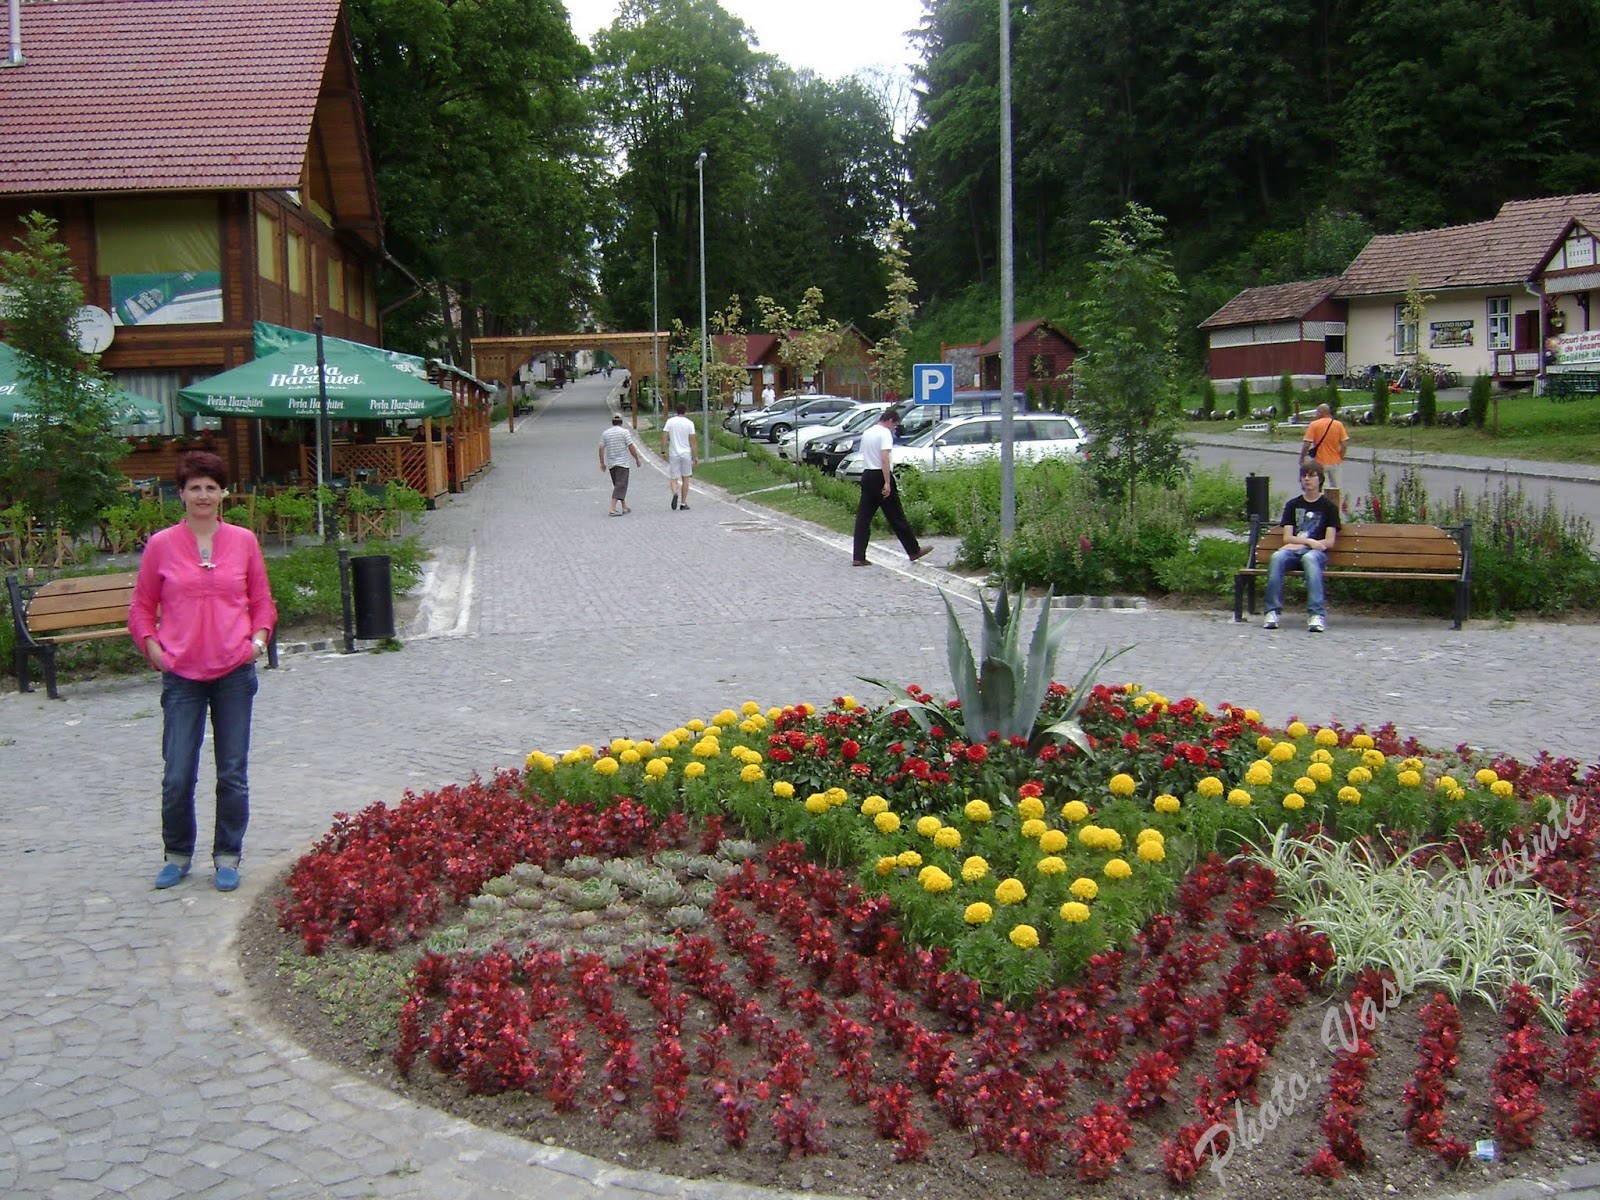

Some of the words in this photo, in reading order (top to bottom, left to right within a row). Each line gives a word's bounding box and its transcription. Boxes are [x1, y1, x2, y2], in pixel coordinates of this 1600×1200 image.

[1556, 335, 1579, 345] Jocuri
[921, 369, 945, 400] P
[207, 395, 227, 406] Perla
[228, 395, 264, 408] Harghitei
[288, 398, 308, 409] Perla
[370, 399, 389, 410] Perla
[391, 399, 425, 411] Harghitei
